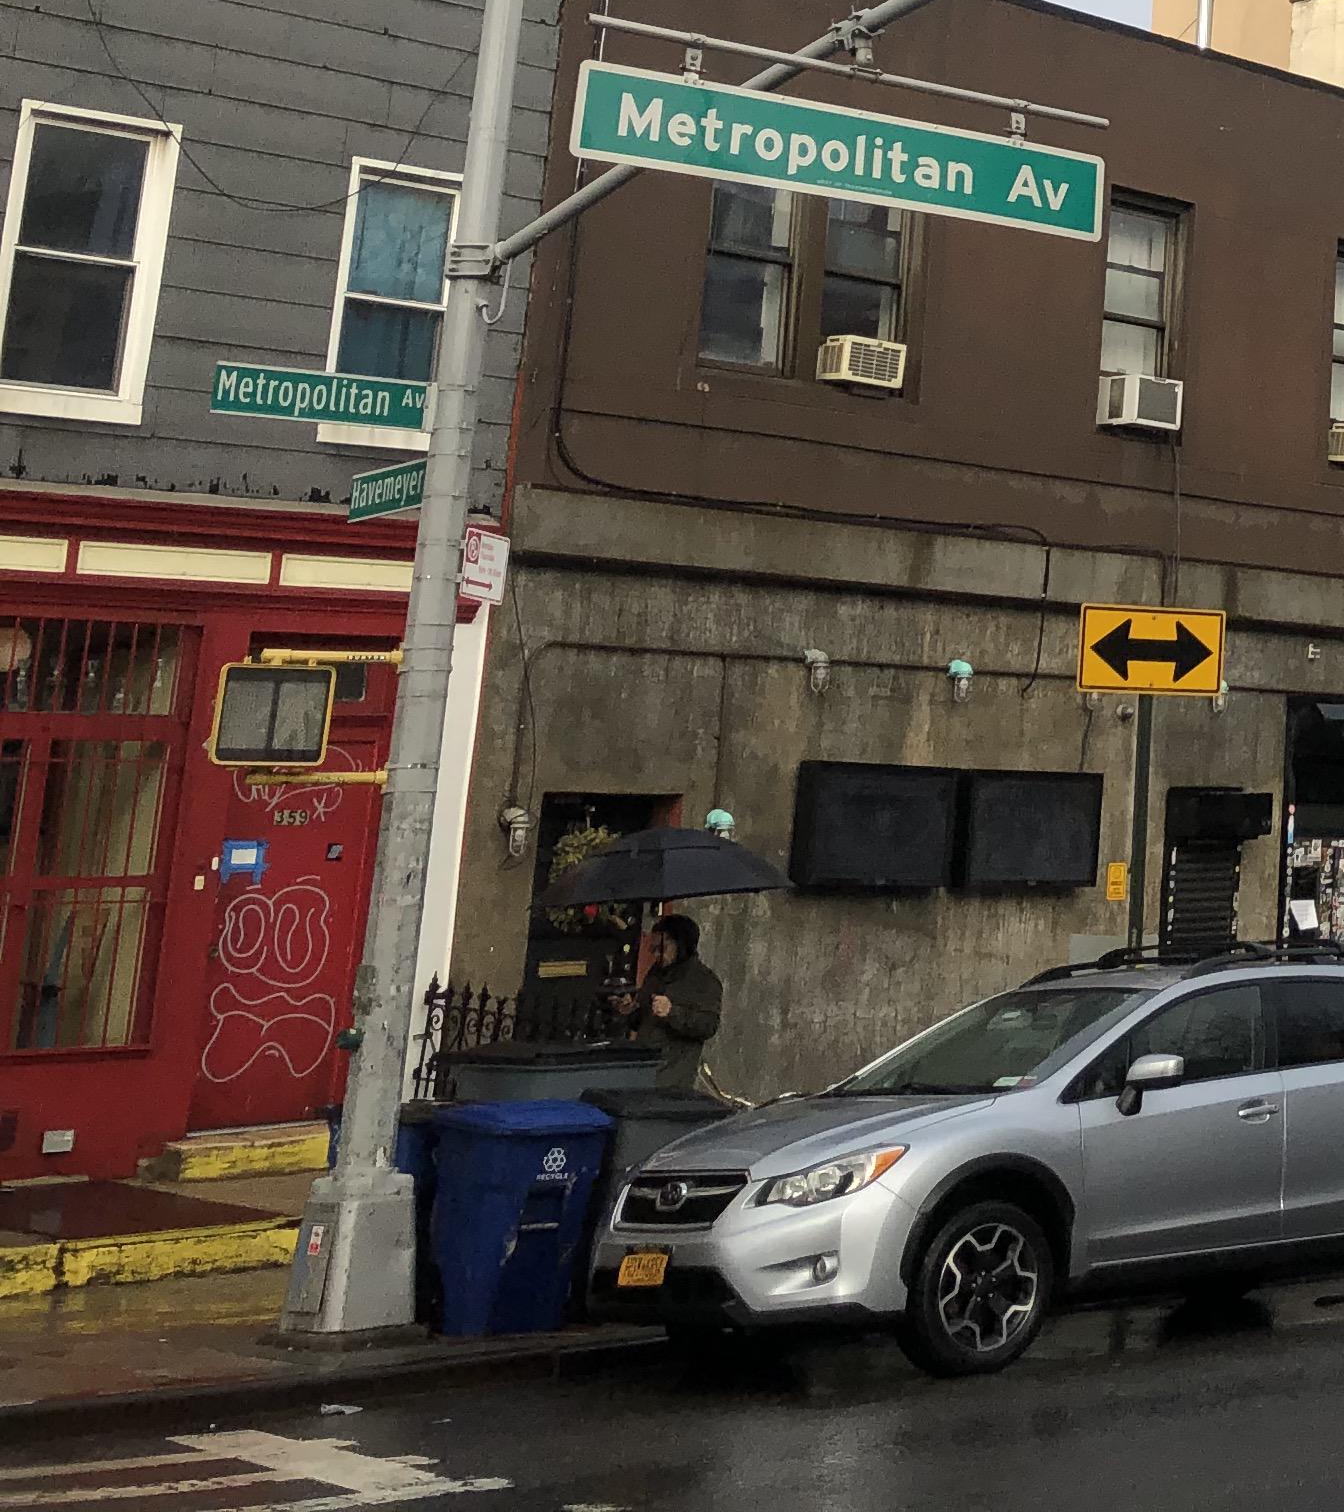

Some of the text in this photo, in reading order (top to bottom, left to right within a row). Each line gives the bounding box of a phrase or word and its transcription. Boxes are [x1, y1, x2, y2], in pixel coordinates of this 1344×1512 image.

[617, 92, 1070, 212] Metropolitan Av
[217, 369, 425, 417] Metropolitan Av
[351, 469, 424, 510] Havemeyer
[275, 810, 308, 824] 359
